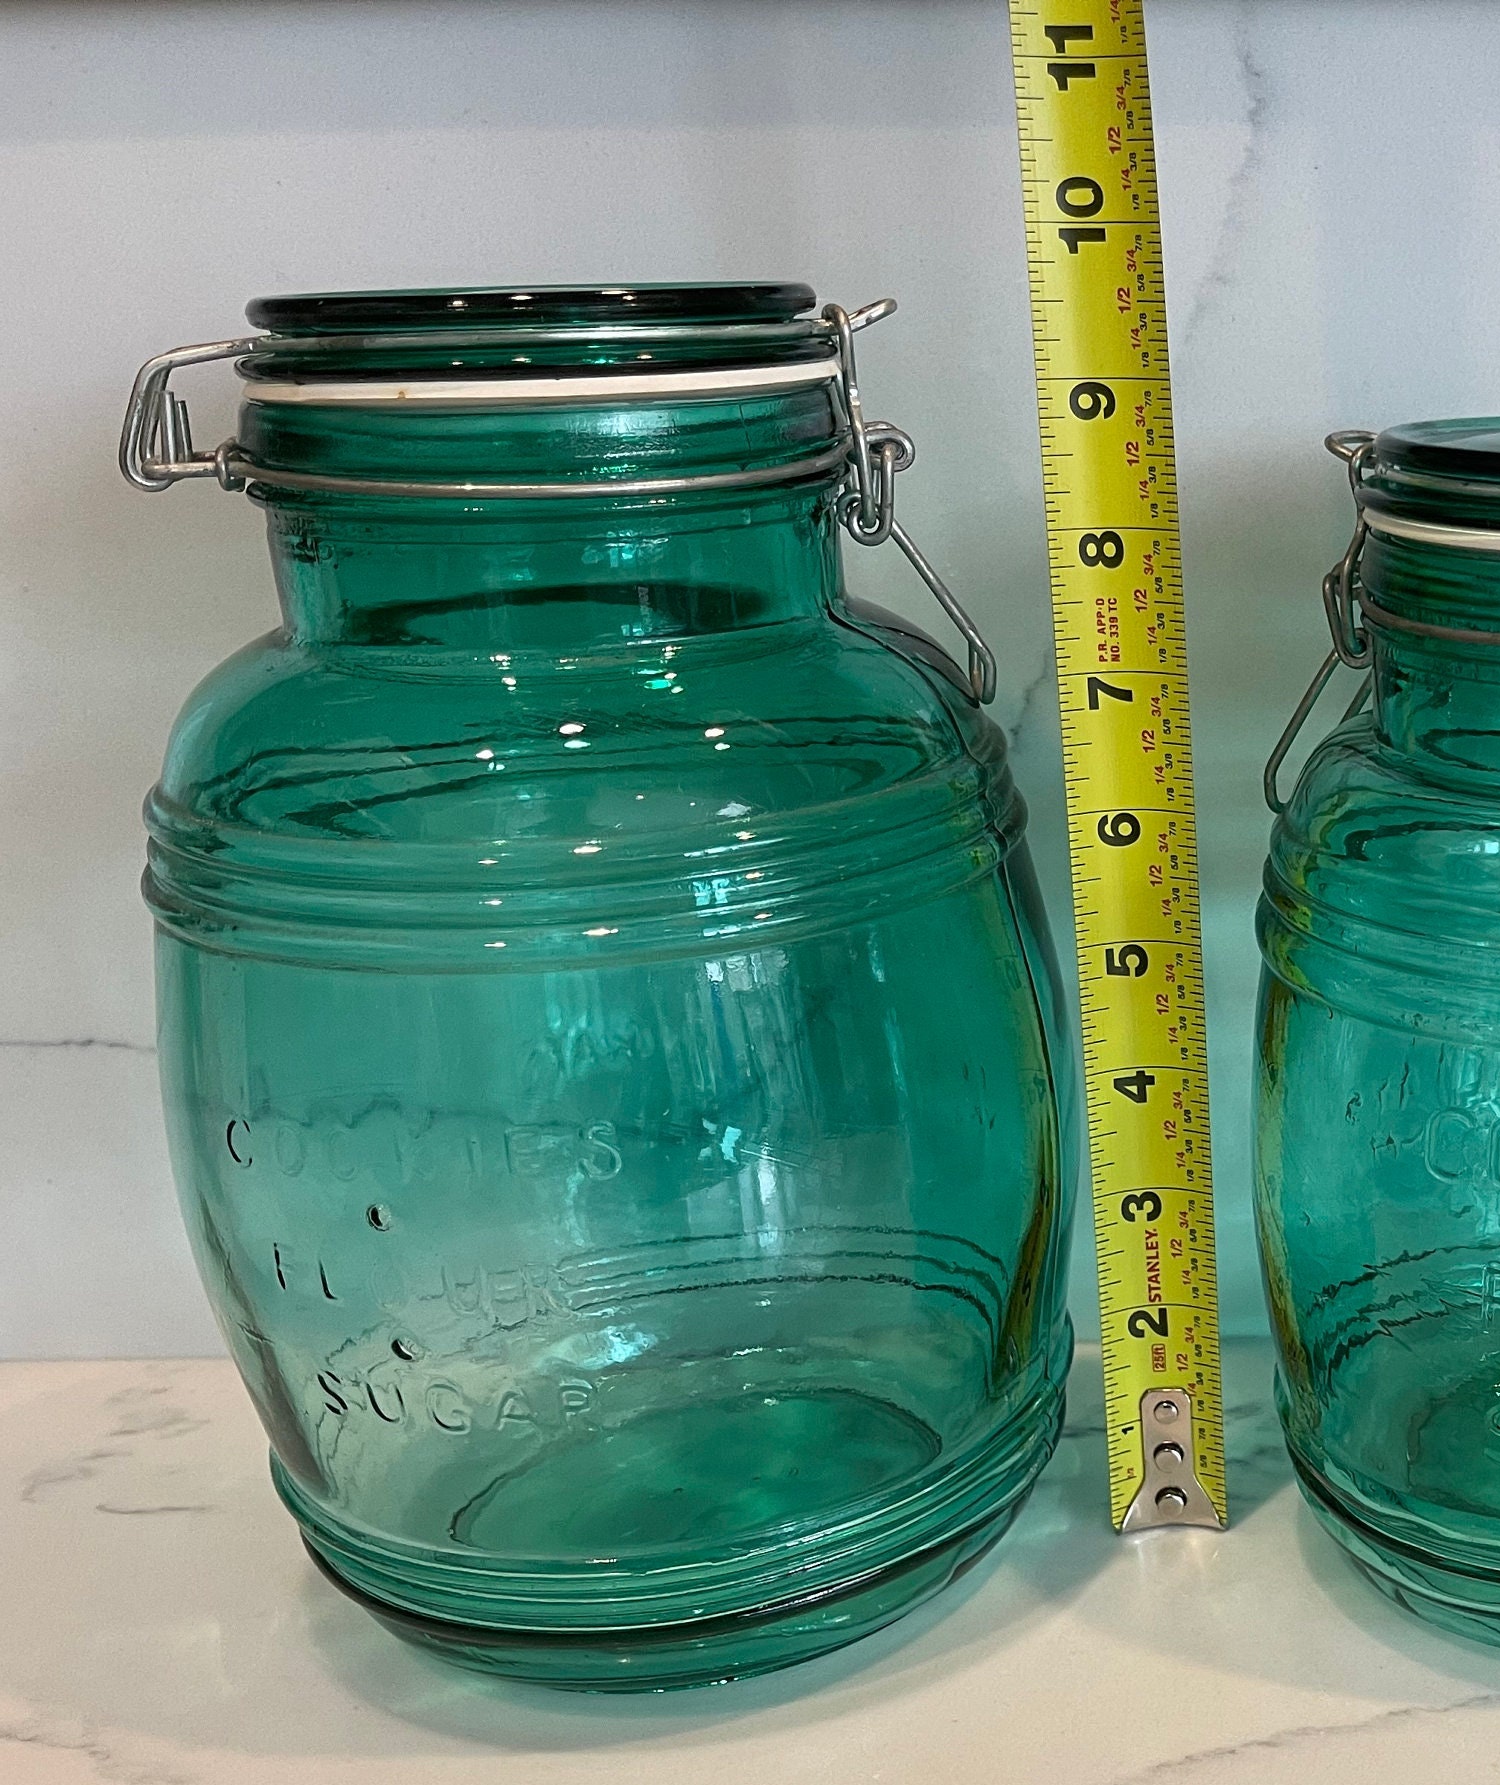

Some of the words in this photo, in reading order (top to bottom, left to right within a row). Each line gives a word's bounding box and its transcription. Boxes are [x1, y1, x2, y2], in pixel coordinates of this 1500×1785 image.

[1044, 25, 1096, 91] 11
[1116, 86, 1126, 110] 3/4
[1108, 127, 1121, 154] 1/2
[1122, 169, 1131, 190] 1/4
[1056, 177, 1106, 254] 10
[1127, 249, 1137, 271] 3/4
[1118, 288, 1131, 313] 1/2
[1131, 327, 1142, 349] 1/4
[1070, 382, 1115, 420] 9
[1135, 406, 1145, 427] 3/4
[1126, 442, 1139, 466] 1/2
[1139, 480, 1149, 500] 1/4
[1079, 531, 1124, 568] 8
[1143, 553, 1155, 575] 3/4
[1108, 598, 1117, 612] TC
[1134, 590, 1147, 612] 1/2
[1109, 617, 1118, 637] 339
[1148, 627, 1157, 645] 1/4
[1088, 677, 1133, 710] 7
[1151, 697, 1161, 717] 3/4
[1142, 730, 1155, 752] 1/2
[1155, 766, 1165, 784] 1/4
[1097, 811, 1140, 846] 6
[1158, 834, 1168, 852] 3/4
[1149, 865, 1162, 886] 1/2
[1162, 899, 1171, 916] 1/4
[1104, 943, 1148, 977] 5
[1166, 964, 1175, 982] 3/4
[1156, 994, 1169, 1015] 1/2
[1168, 1027, 1178, 1043] 1/4
[1112, 1070, 1155, 1103] 4
[1173, 1092, 1183, 1109] 3/4
[1164, 1121, 1176, 1140] 1/2
[1176, 1152, 1185, 1168] 1/4
[1120, 1191, 1162, 1222] 3
[1179, 1212, 1188, 1228] 3/4
[1171, 1239, 1183, 1258] 1/2
[1182, 1271, 1191, 1284] 1/4
[1127, 1307, 1168, 1338] 2
[1185, 1328, 1194, 1343] 3/4
[1154, 1344, 1166, 1368] 25ft
[1177, 1354, 1188, 1371] 1/2
